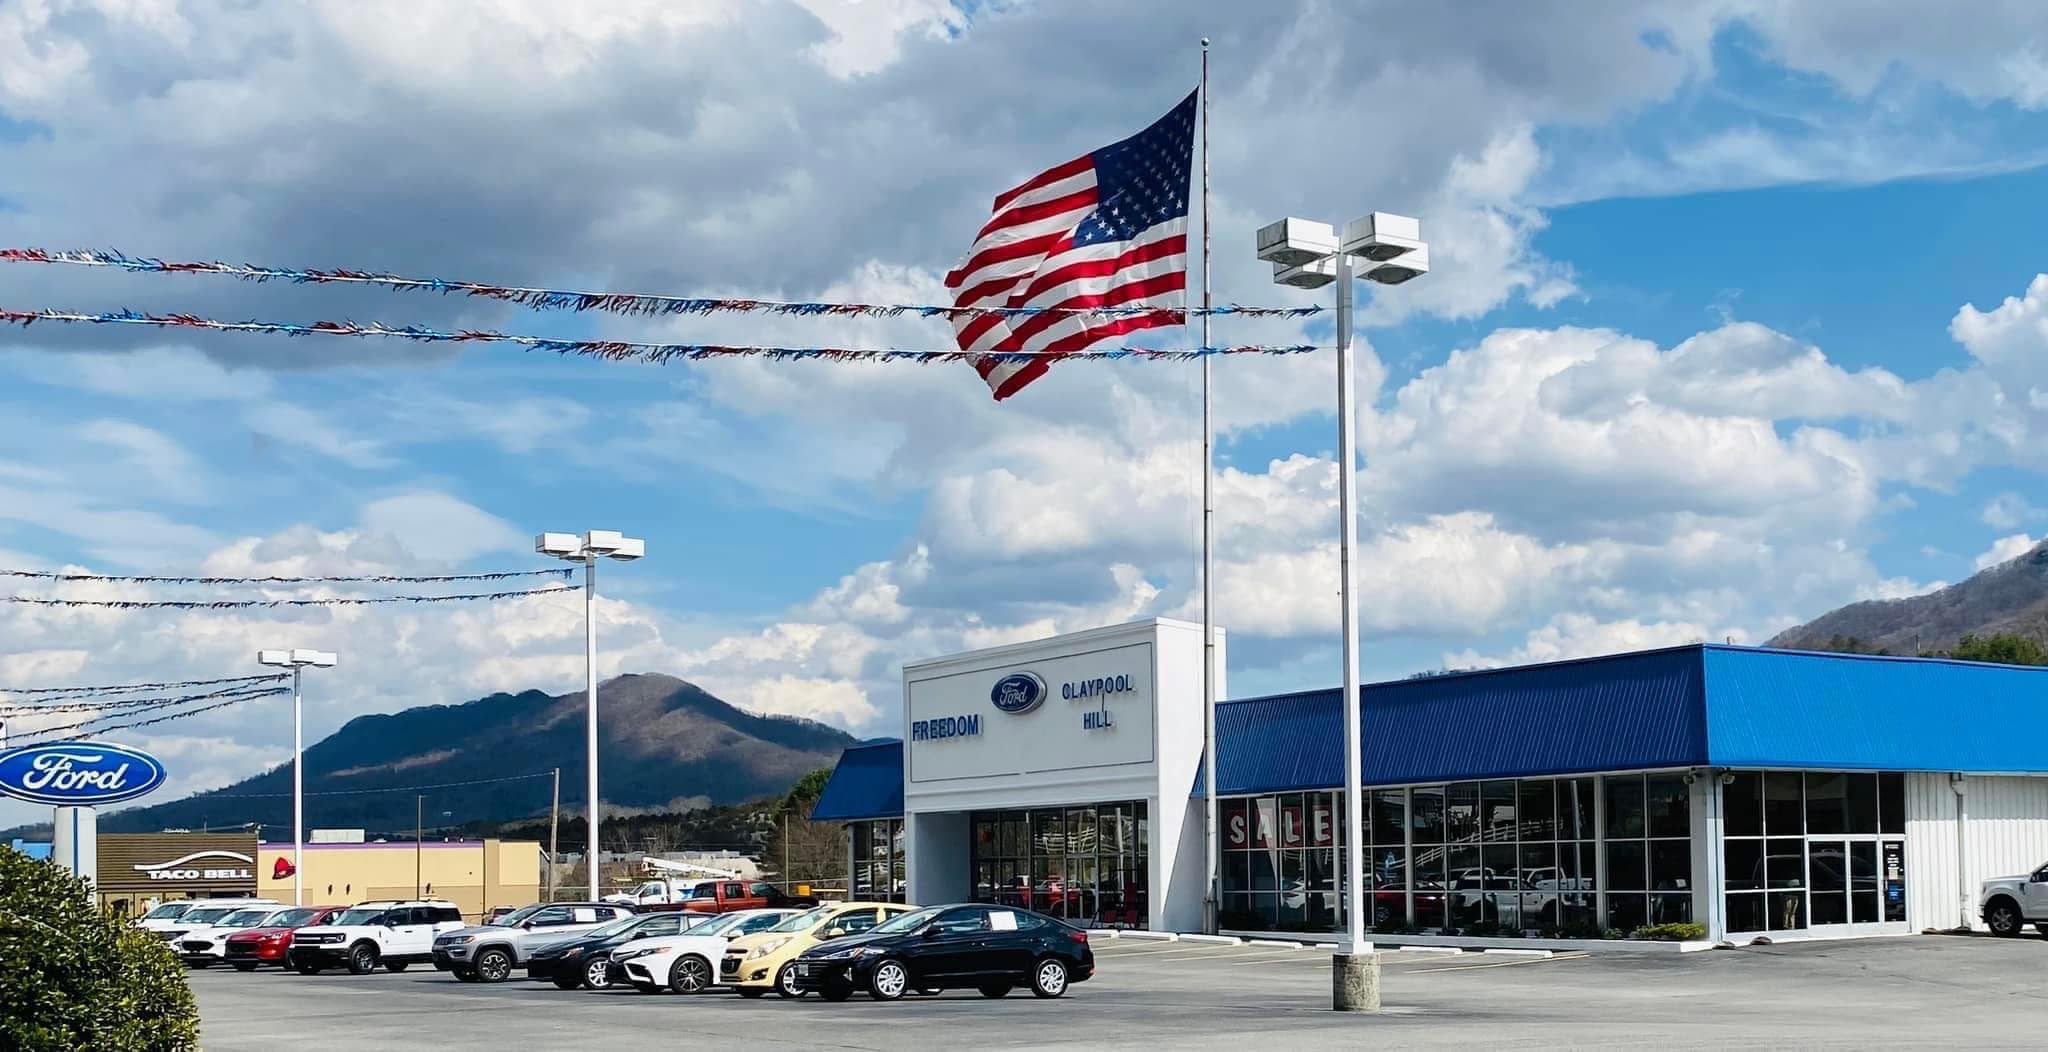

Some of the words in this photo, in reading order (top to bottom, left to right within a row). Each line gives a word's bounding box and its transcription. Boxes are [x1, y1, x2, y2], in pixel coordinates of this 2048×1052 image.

[1000, 681, 1029, 706] Ford
[1062, 674, 1133, 699] CLAYPOOL
[912, 714, 979, 741] FREEDOM
[1083, 711, 1112, 730] HILL
[23, 753, 129, 790] Ford
[1230, 810, 1331, 844] SALE
[147, 870, 200, 880] TACO
[204, 869, 253, 879] BELL
